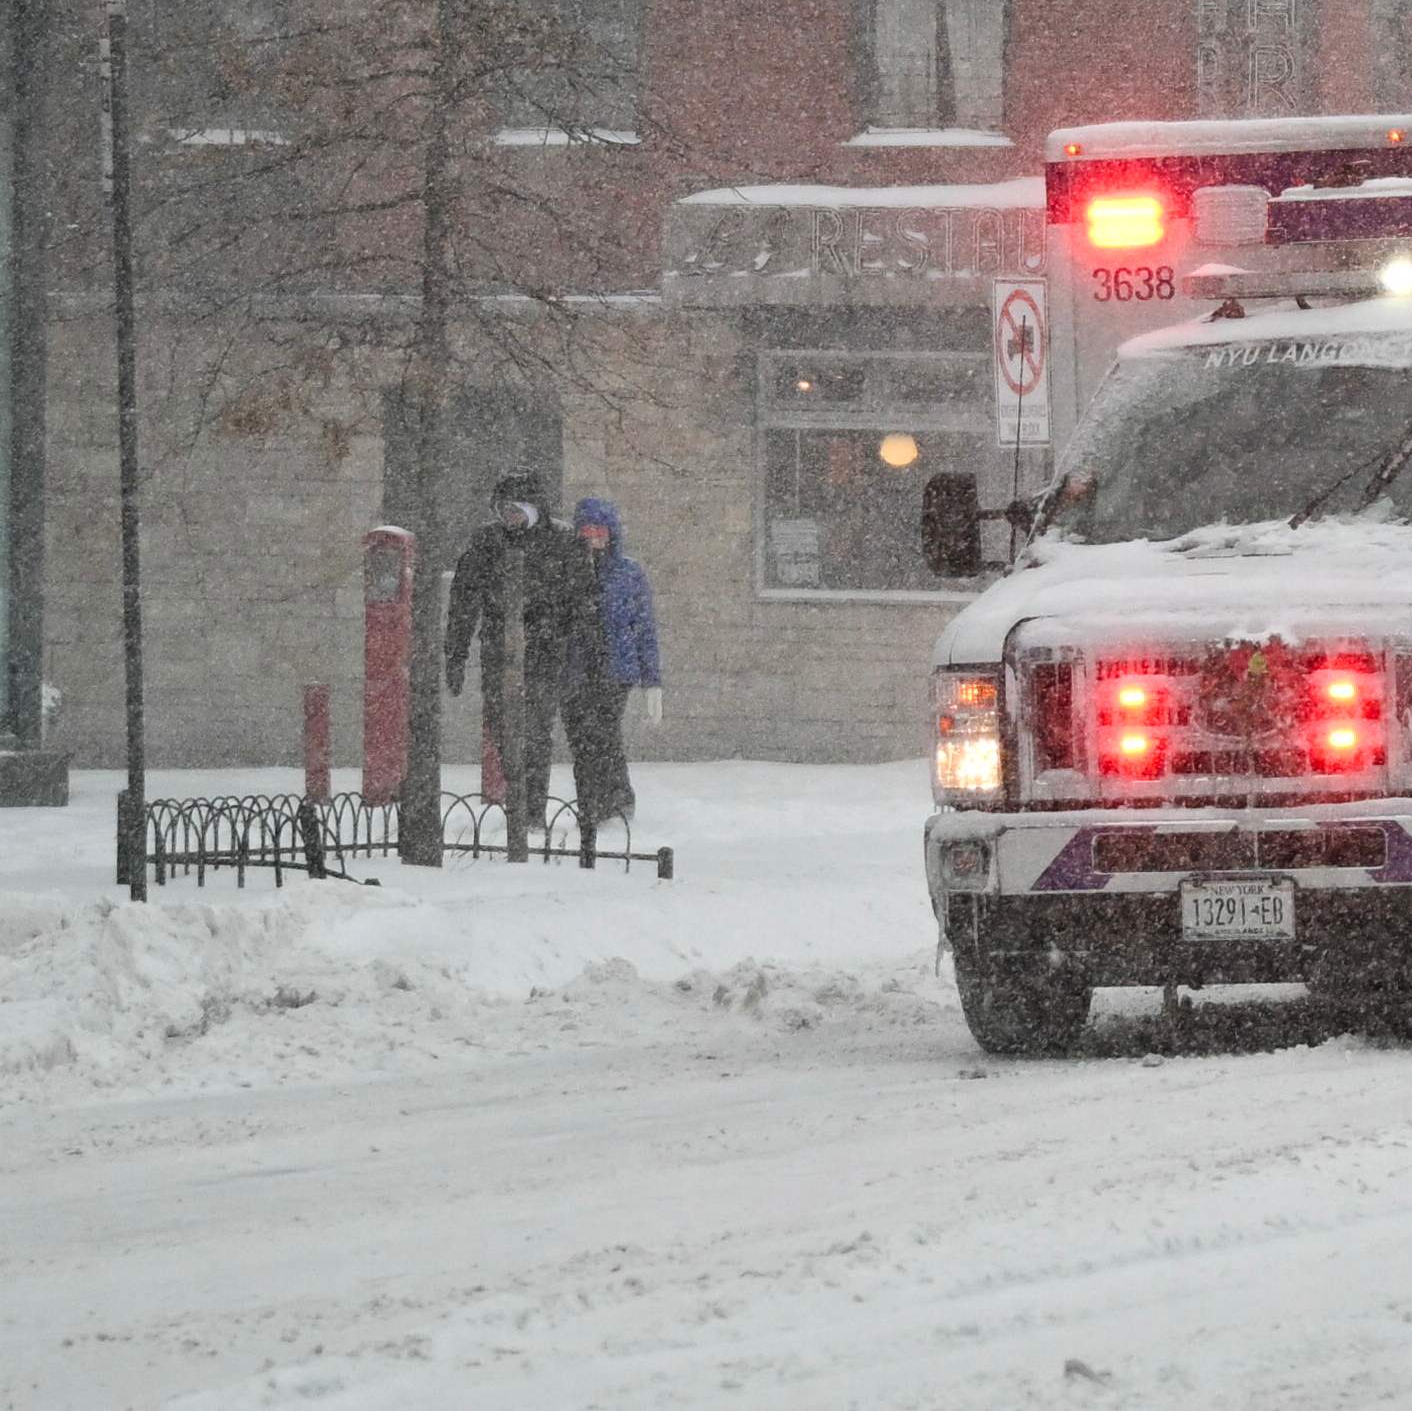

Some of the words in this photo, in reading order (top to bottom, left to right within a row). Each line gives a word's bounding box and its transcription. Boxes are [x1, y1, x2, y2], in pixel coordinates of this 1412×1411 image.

[810, 206, 1048, 278] RESTAU
[1092, 265, 1176, 302] 3638
[1203, 344, 1262, 369] NYU
[1237, 884, 1265, 894] YORK
